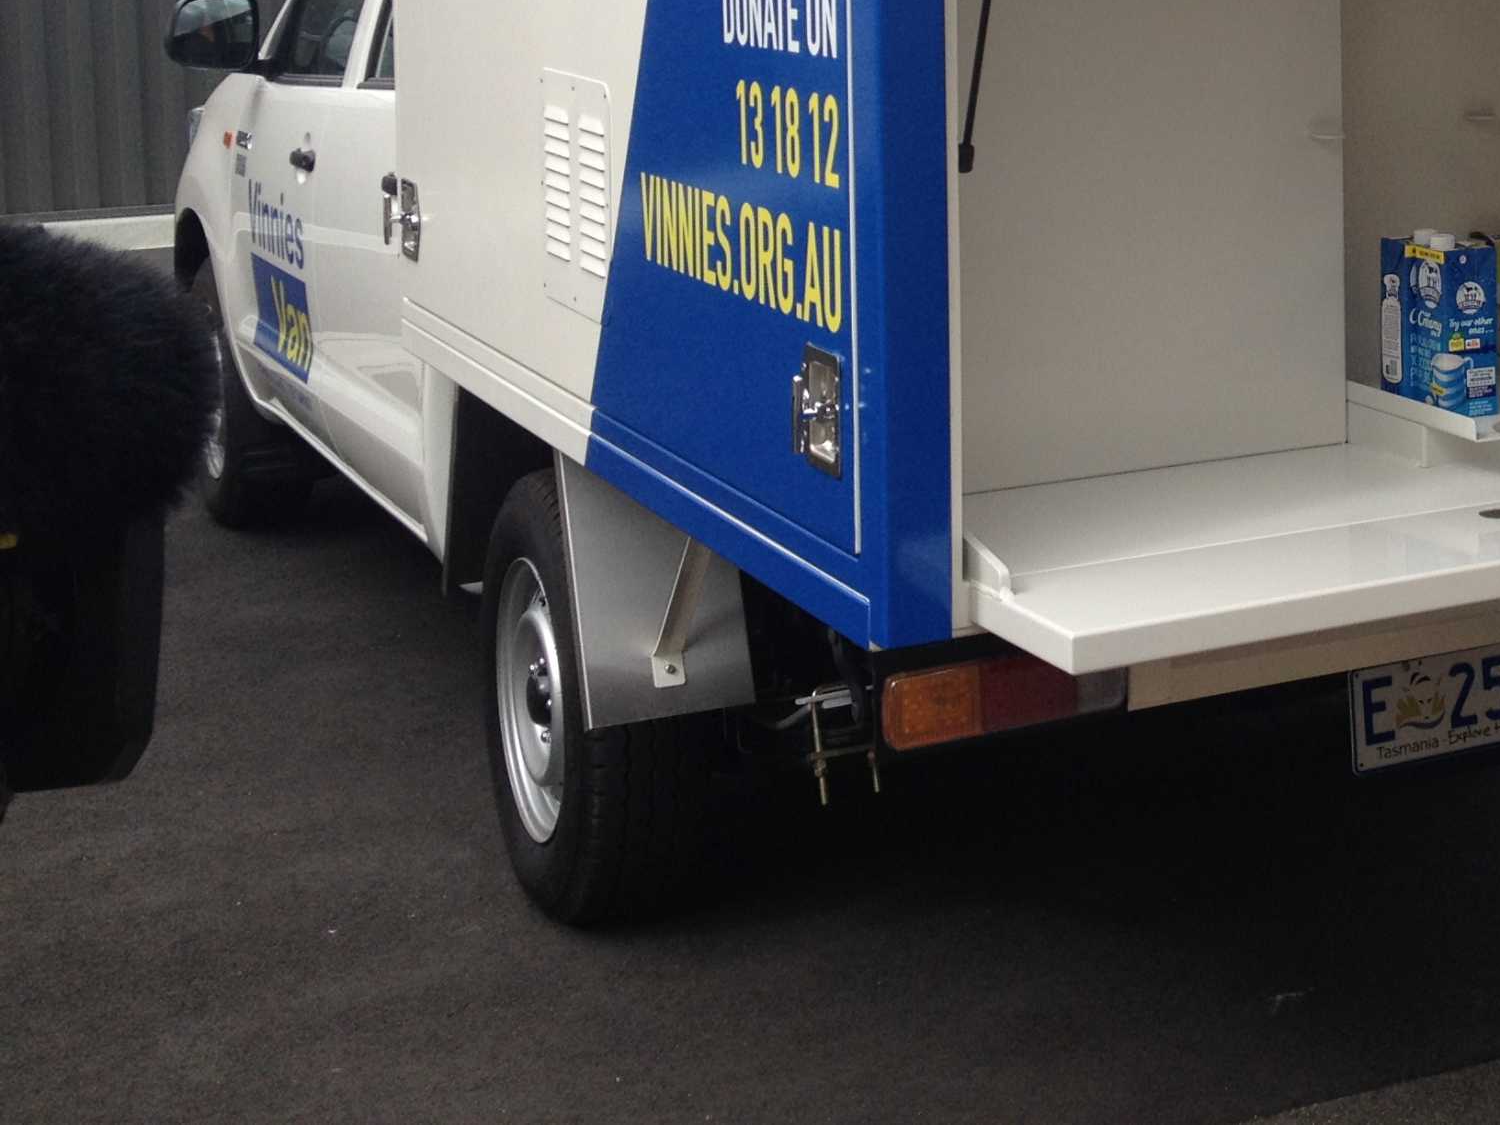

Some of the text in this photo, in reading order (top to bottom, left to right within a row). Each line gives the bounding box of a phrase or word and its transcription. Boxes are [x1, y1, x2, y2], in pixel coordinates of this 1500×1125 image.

[735, 79, 841, 189] 13 18 12
[248, 178, 304, 269] Vinnies
[641, 171, 842, 333] VINNIES.ORG.AU
[270, 275, 313, 372] Van
[1362, 675, 1396, 746] E
[1376, 736, 1440, 760] Tasmania
[1448, 725, 1491, 745] Explore
